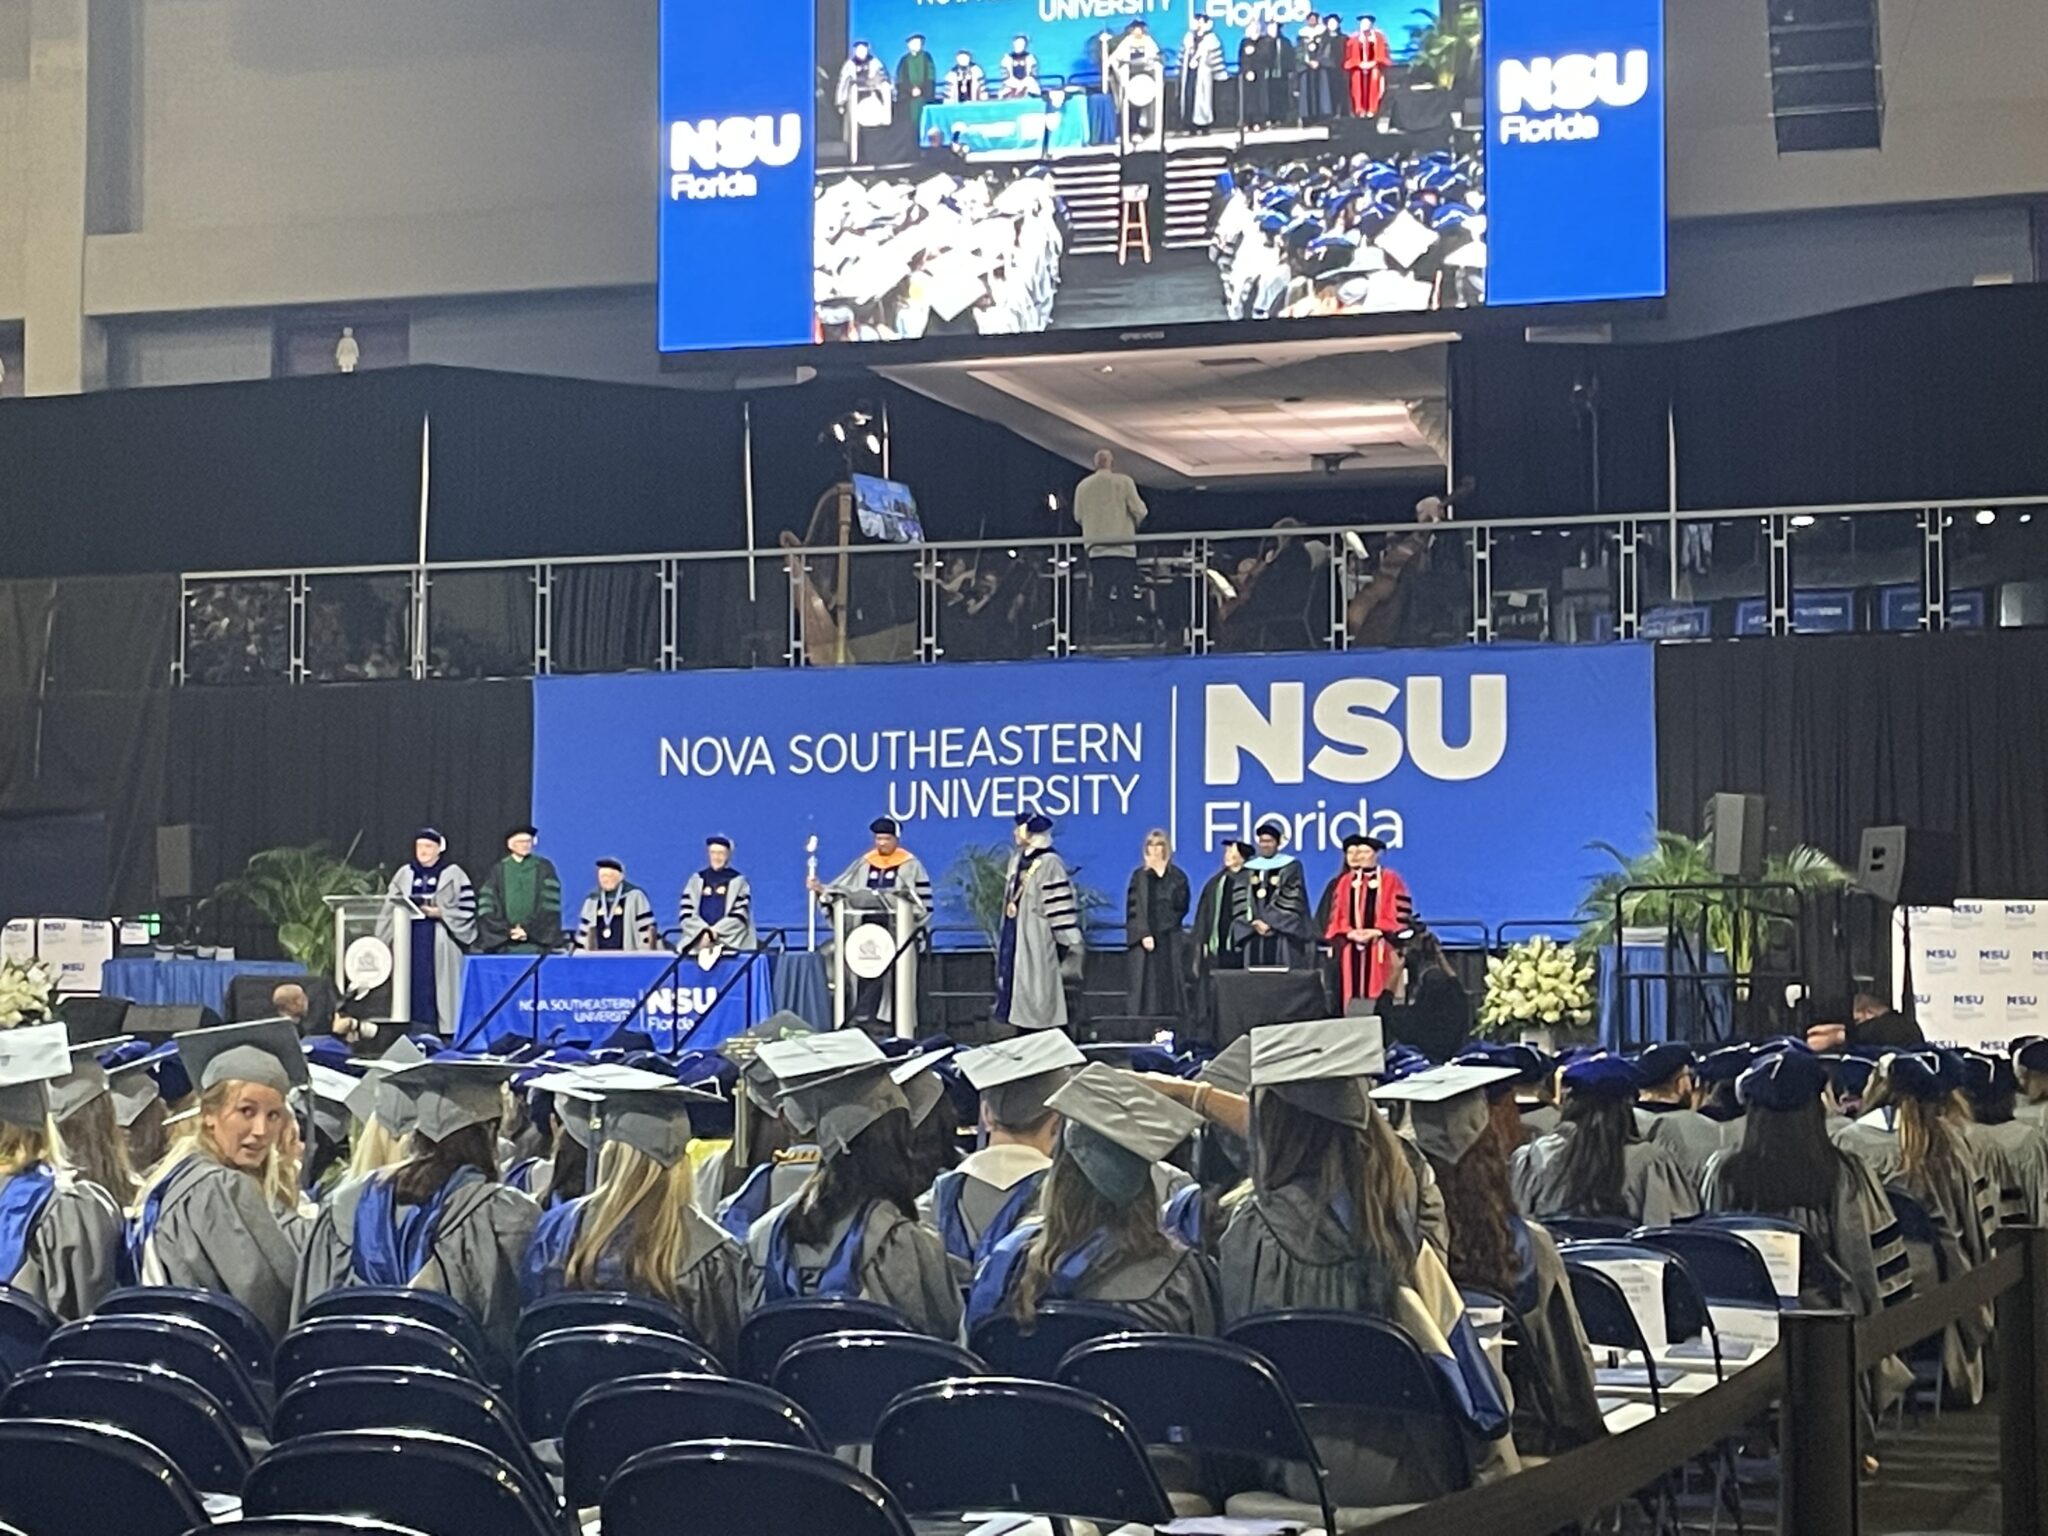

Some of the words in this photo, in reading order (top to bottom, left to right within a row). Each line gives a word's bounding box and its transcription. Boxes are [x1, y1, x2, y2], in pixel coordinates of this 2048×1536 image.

[1498, 48, 1649, 114] NSU
[670, 112, 803, 172] NSU
[1500, 112, 1600, 144] Florida
[670, 169, 758, 201] Florida
[1204, 674, 1508, 785] NSU
[659, 735, 776, 777] NOVA
[787, 721, 1143, 775] SOUTHEASTERN
[888, 773, 1141, 822] UNIVERSITY
[1204, 798, 1405, 852] Florida
[2004, 904, 2036, 914] NSU
[1926, 949, 1957, 959] NSU
[1979, 950, 2010, 960] NSU
[519, 999, 550, 1011] NOA
[551, 998, 636, 1011] SOUTHEASTERN
[646, 987, 717, 1015] NSU
[1953, 995, 1984, 1005] NSU
[2007, 996, 2038, 1006] NSU
[574, 1010, 631, 1023] UNIVERSIT
[648, 1016, 695, 1031] Florda
